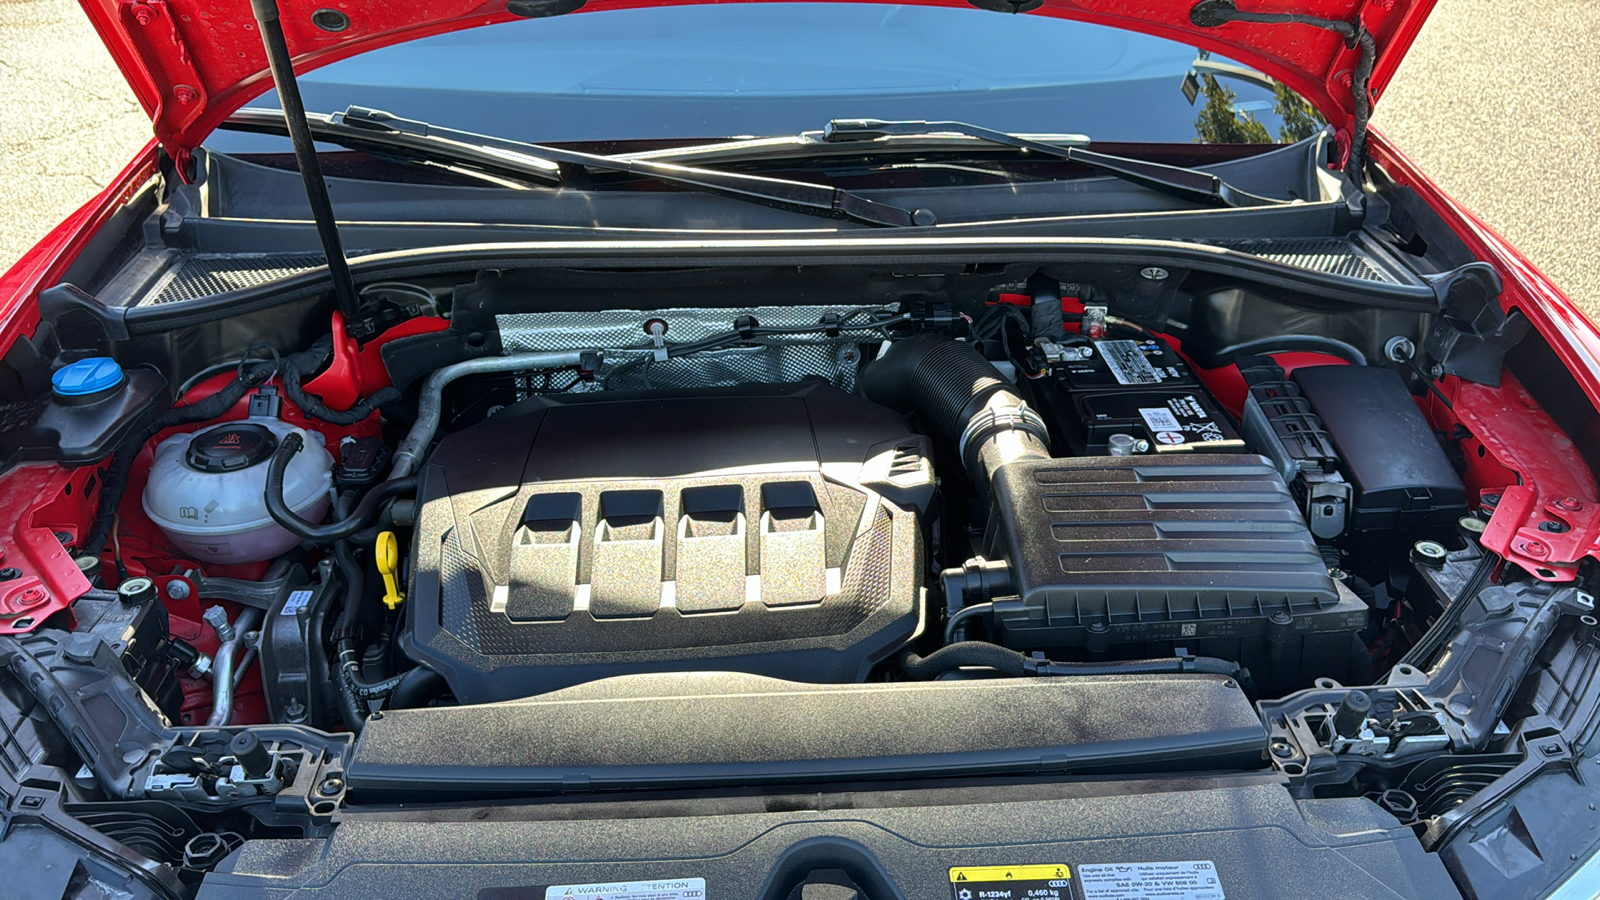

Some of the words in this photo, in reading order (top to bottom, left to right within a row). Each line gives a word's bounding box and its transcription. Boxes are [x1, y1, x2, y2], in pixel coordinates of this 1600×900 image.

[577, 885, 628, 894] WARNING
[639, 882, 689, 890] TENTION
[978, 890, 1012, 898] R-1234yf
[1027, 889, 1048, 897] 0,460
[1049, 889, 1059, 897] kg
